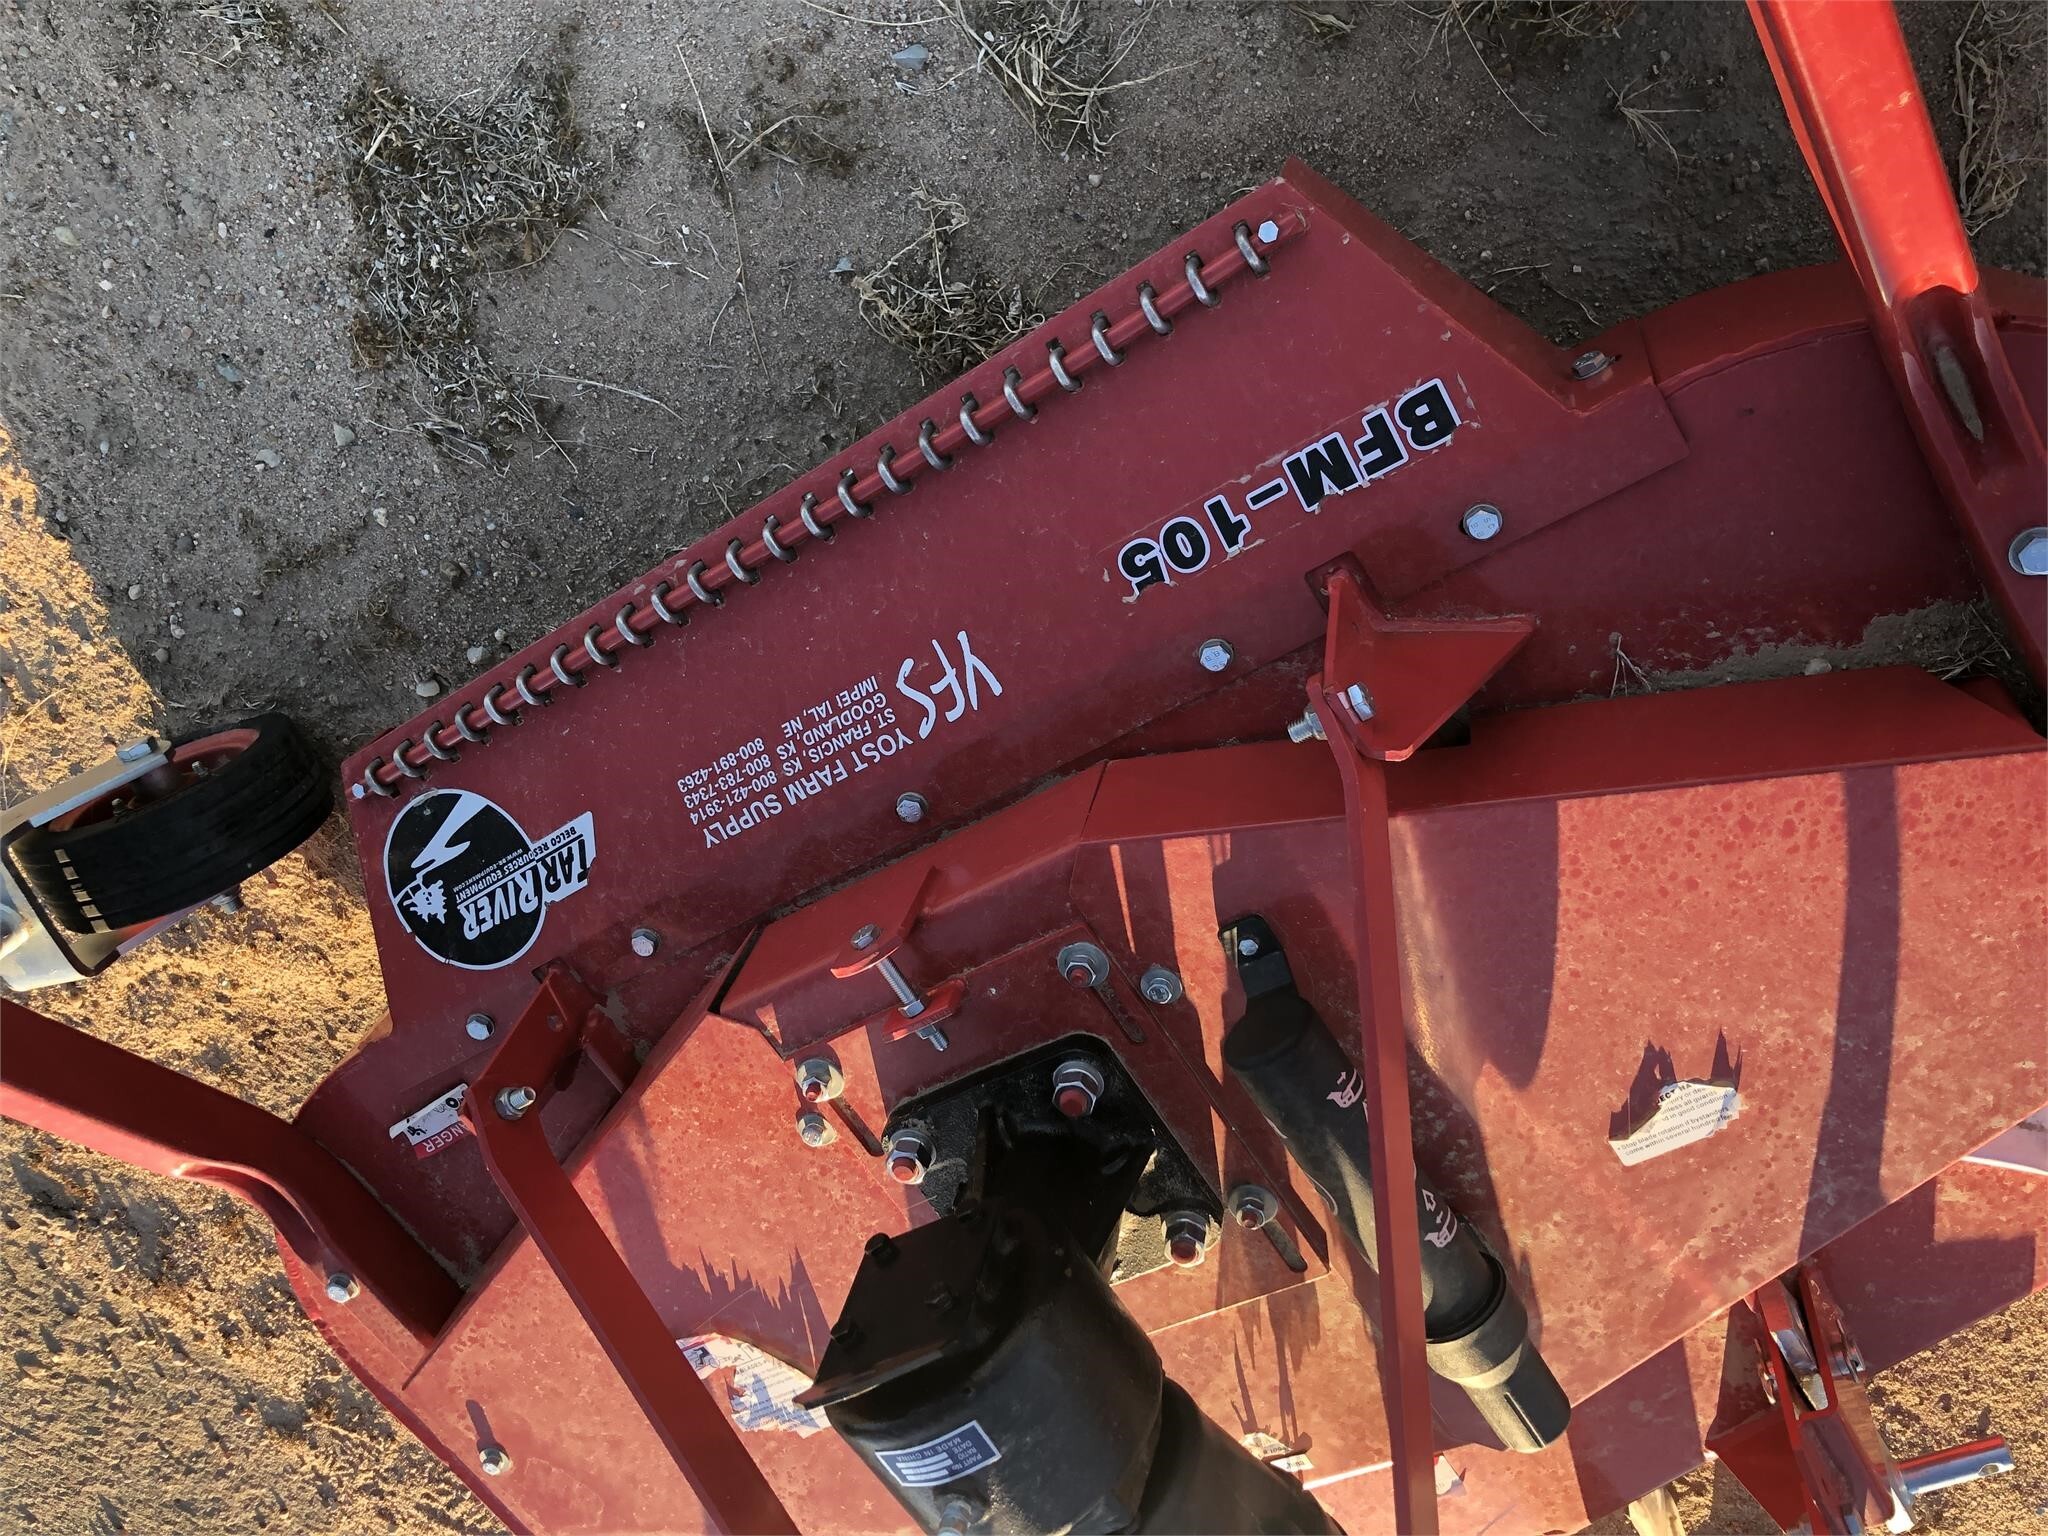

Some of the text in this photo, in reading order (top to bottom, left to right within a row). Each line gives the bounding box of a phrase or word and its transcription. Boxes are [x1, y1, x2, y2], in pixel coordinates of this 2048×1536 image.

[1117, 376, 1462, 603] BFM-105
[896, 630, 1002, 739] YFS
[683, 692, 887, 809] GOODLAND, KS 800-783-7343
[781, 716, 802, 737] NE
[677, 737, 765, 793] 800-891-4263
[689, 708, 896, 825] ST. FRANCIS, KS 800-421-3914
[702, 728, 914, 849] YOST FARM SUPPLY
[455, 826, 577, 903] BELCO RESOURCES EQUIPMENT
[459, 839, 589, 940] TAR RIVER
[1621, 1140, 1638, 1151] Stop
[1639, 1133, 1658, 1145] blade
[1658, 1123, 1685, 1138] rotation
[1678, 1107, 1696, 1118] good
[1697, 1094, 1728, 1110] condition
[1645, 1139, 1665, 1150] within
[896, 1437, 962, 1462] MADE IN CHINA
[952, 1439, 973, 1454] DATE
